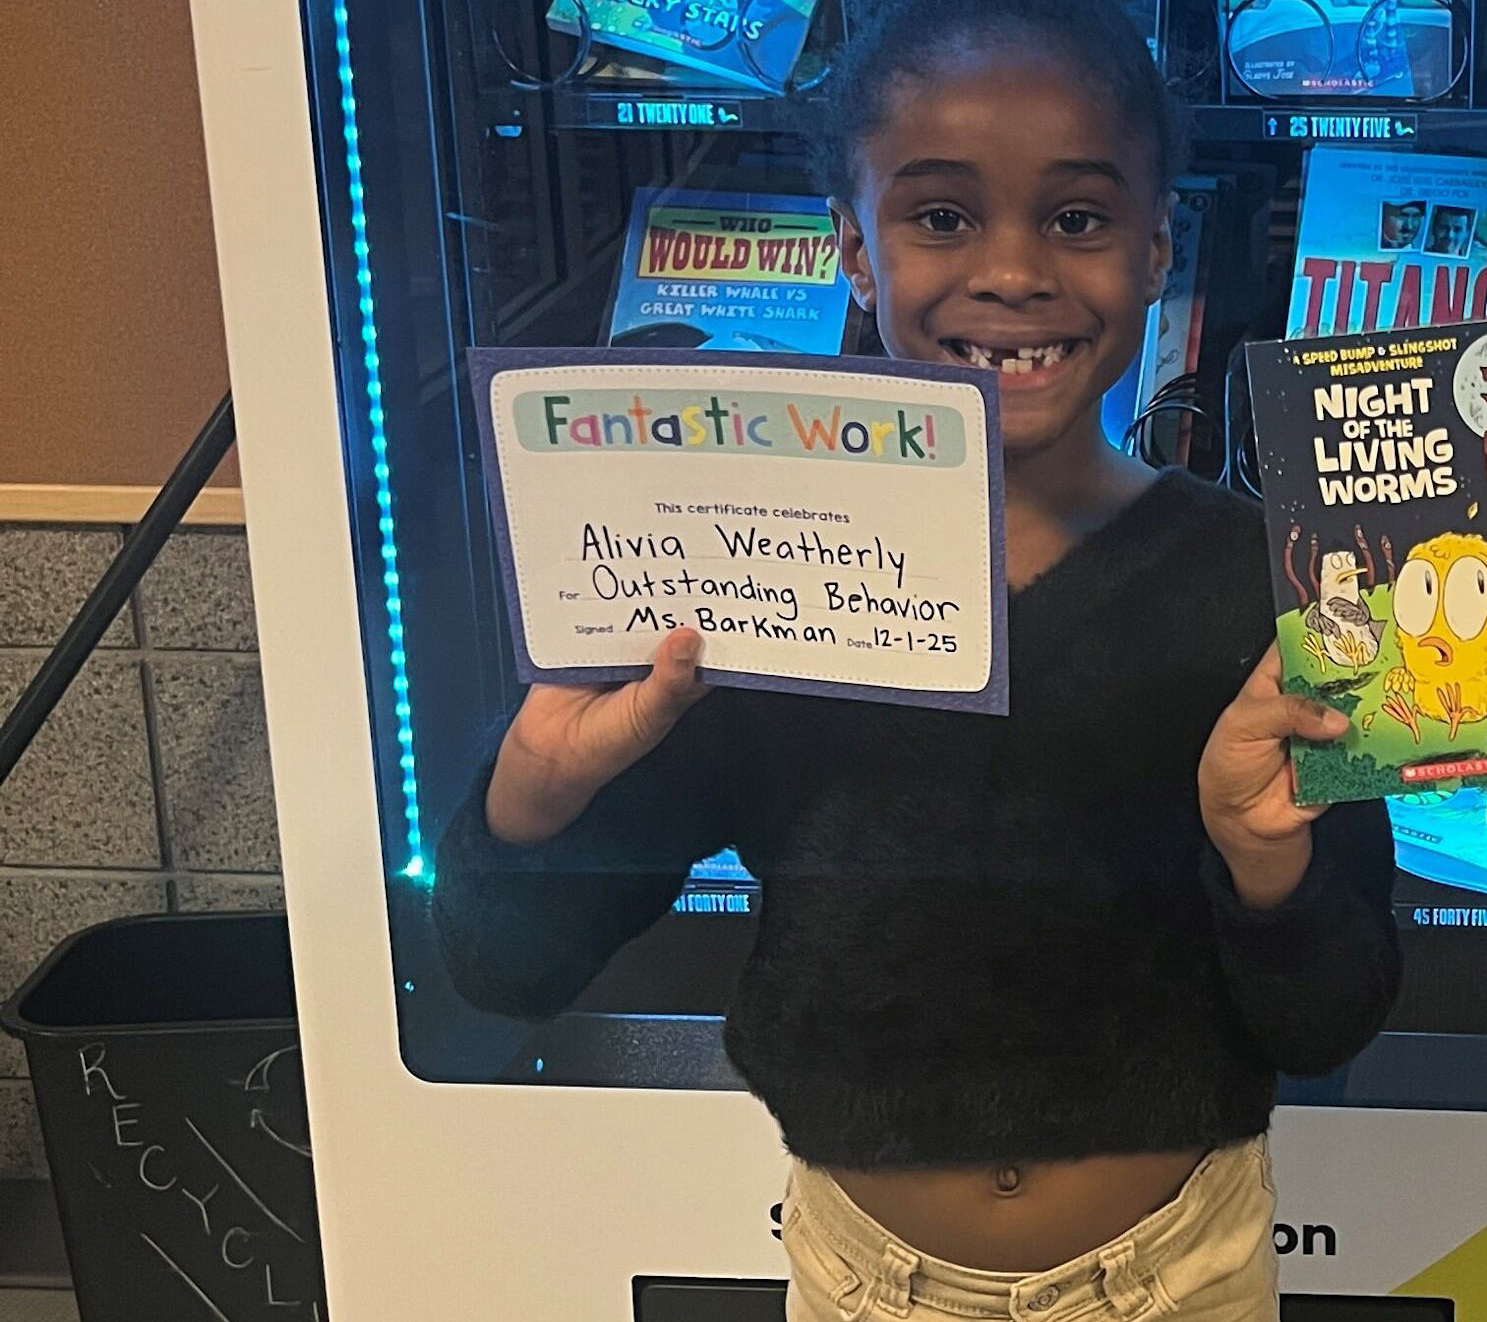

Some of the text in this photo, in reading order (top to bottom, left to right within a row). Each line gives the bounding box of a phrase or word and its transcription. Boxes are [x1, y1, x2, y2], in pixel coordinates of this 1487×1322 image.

[1311, 79, 1375, 88] SCHOLASTIC
[617, 102, 715, 126] 21 TWENTY ONE
[1289, 115, 1392, 138] 25 TWENTY FIVE
[718, 214, 772, 234] WHO
[648, 226, 840, 283] WOULD WIN?
[656, 283, 808, 301] KILLER WHALE VS
[640, 301, 820, 322] GREAT WHITE SHARK
[1302, 337, 1458, 366] SPEED BUMP SLINGSHOT
[1330, 357, 1424, 377] MISADVENTURE
[1313, 377, 1434, 421] NIGHT
[543, 395, 939, 462] Fantastic Work!
[1342, 419, 1414, 440] OF THE
[1313, 427, 1455, 474] LIVING
[1318, 466, 1458, 506] WORMS
[654, 501, 851, 525] This certificate celebrates
[581, 523, 907, 590] Alivia Weatherly
[558, 589, 581, 602] For
[592, 564, 961, 623] Outstanding Behavior
[575, 623, 614, 636] Signed
[626, 607, 685, 633] Ms.
[846, 637, 874, 651] Date
[873, 628, 958, 654] 12-1-25
[687, 894, 751, 912] FORTY ONE
[1413, 908, 1430, 925] 45
[1432, 908, 1471, 926] FORTY
